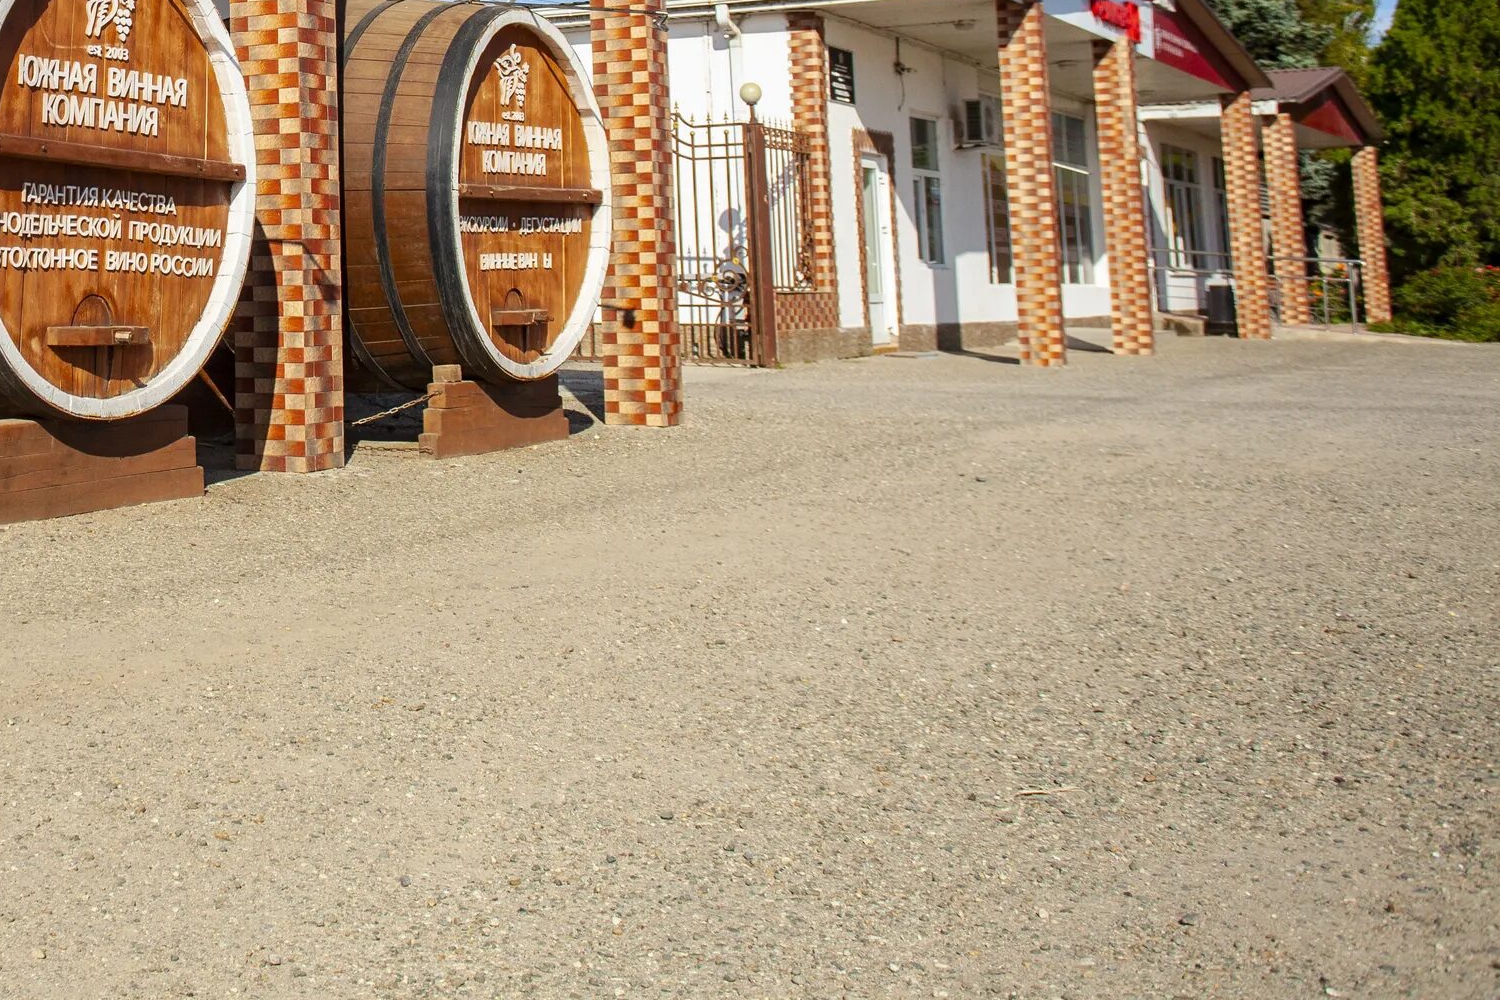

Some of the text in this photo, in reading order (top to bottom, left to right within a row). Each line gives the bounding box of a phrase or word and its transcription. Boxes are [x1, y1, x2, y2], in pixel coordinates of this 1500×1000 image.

[105, 47, 129, 61] 2003
[17, 54, 188, 107] ЮЖНАЯ ВИННАЯ
[42, 92, 158, 136] КОМПАНИЯ
[467, 121, 562, 150] ЮЖНАЯ ВИННАЯ
[482, 150, 546, 175] КОМПАНИЯ
[21, 182, 177, 215] ГАРАНТИЯ КАЧЕСТВА
[128, 221, 221, 249] ПРОДУКЦИИ
[519, 216, 582, 236] ДЕГУСТАЦИИ
[105, 250, 147, 273] ВИНО
[150, 254, 213, 277] РОССИИ
